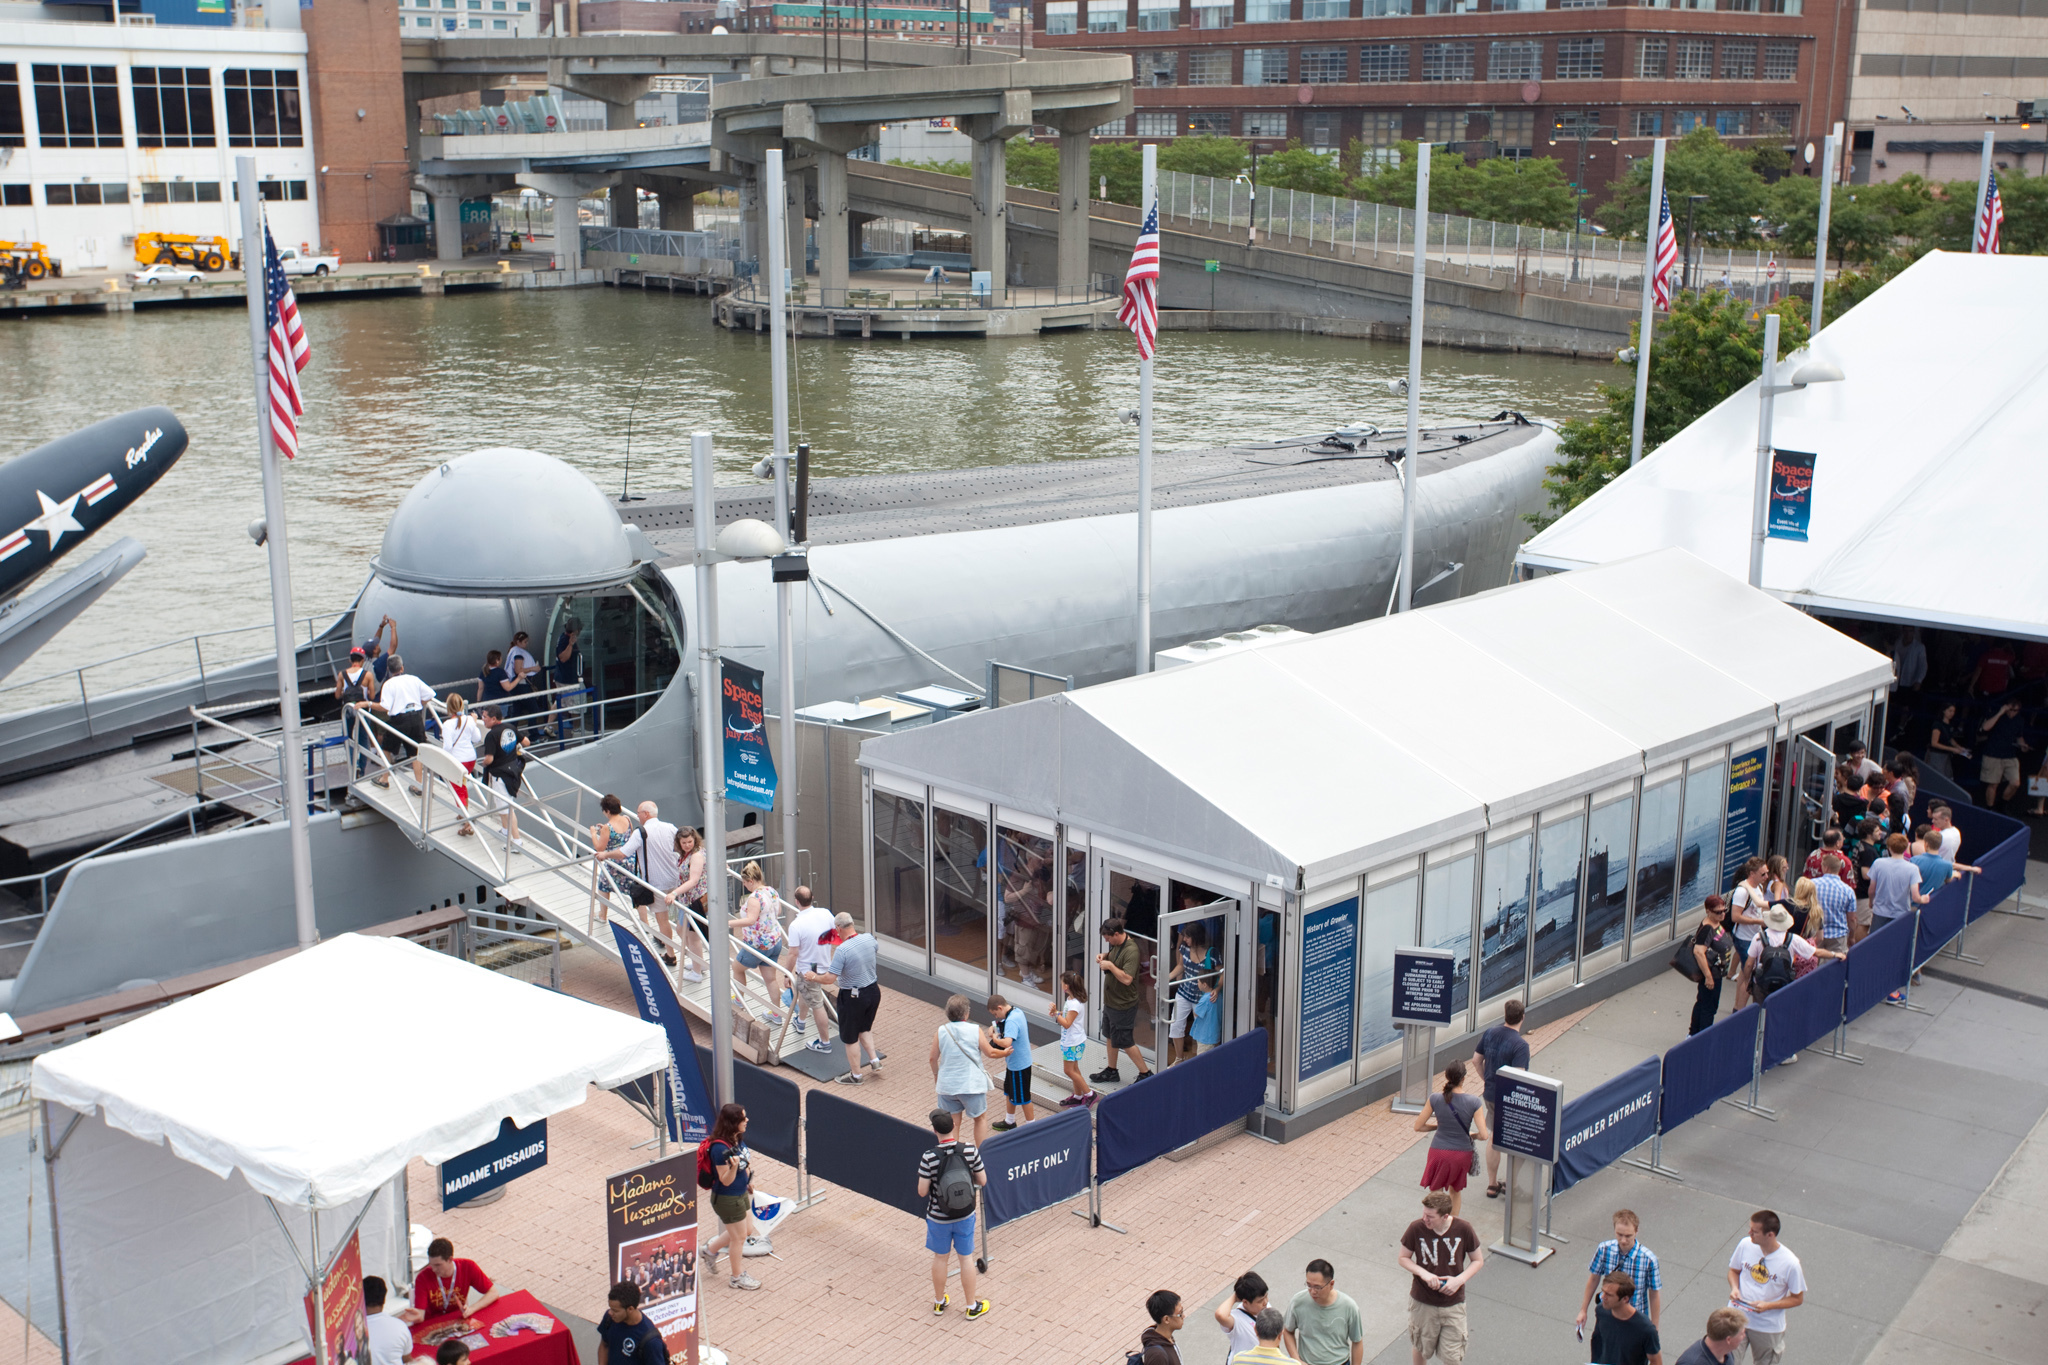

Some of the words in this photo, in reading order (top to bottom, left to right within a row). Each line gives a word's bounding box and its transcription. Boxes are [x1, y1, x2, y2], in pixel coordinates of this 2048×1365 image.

[929, 118, 951, 127] FedEx
[1774, 461, 1813, 477] Space
[1785, 475, 1812, 489] Fest
[1772, 492, 1784, 502] July
[723, 677, 762, 708] Space
[740, 700, 763, 725] Fest
[725, 727, 742, 742] July
[733, 770, 747, 781] Event
[748, 774, 759, 783] info
[760, 777, 766, 785] at
[1730, 780, 1750, 794] Entrance
[726, 777, 774, 798] intrepidmuseum.org
[1306, 923, 1324, 934] History
[1324, 919, 1330, 928] of
[1330, 914, 1349, 926] Growler
[627, 943, 660, 1017] GROWLER
[1502, 1095, 1548, 1114] RESTRICTIONS:
[1511, 1091, 1540, 1105] GROWLER
[1564, 1119, 1606, 1152] GROWLER
[1608, 1090, 1653, 1128] ENTRANCE
[445, 1164, 491, 1196] MADAME
[492, 1140, 545, 1174] TUSSAUDS
[1007, 1158, 1040, 1181] STAFF
[1043, 1148, 1070, 1169] ONLY
[610, 1174, 677, 1205] Madame
[954, 1189, 964, 1197] CAT
[613, 1187, 687, 1225] Tussauds
[642, 1216, 656, 1226] NEW
[657, 1210, 672, 1221] YORK
[1419, 1236, 1462, 1267] NY
[323, 1258, 350, 1302] adame
[653, 1308, 678, 1321] October
